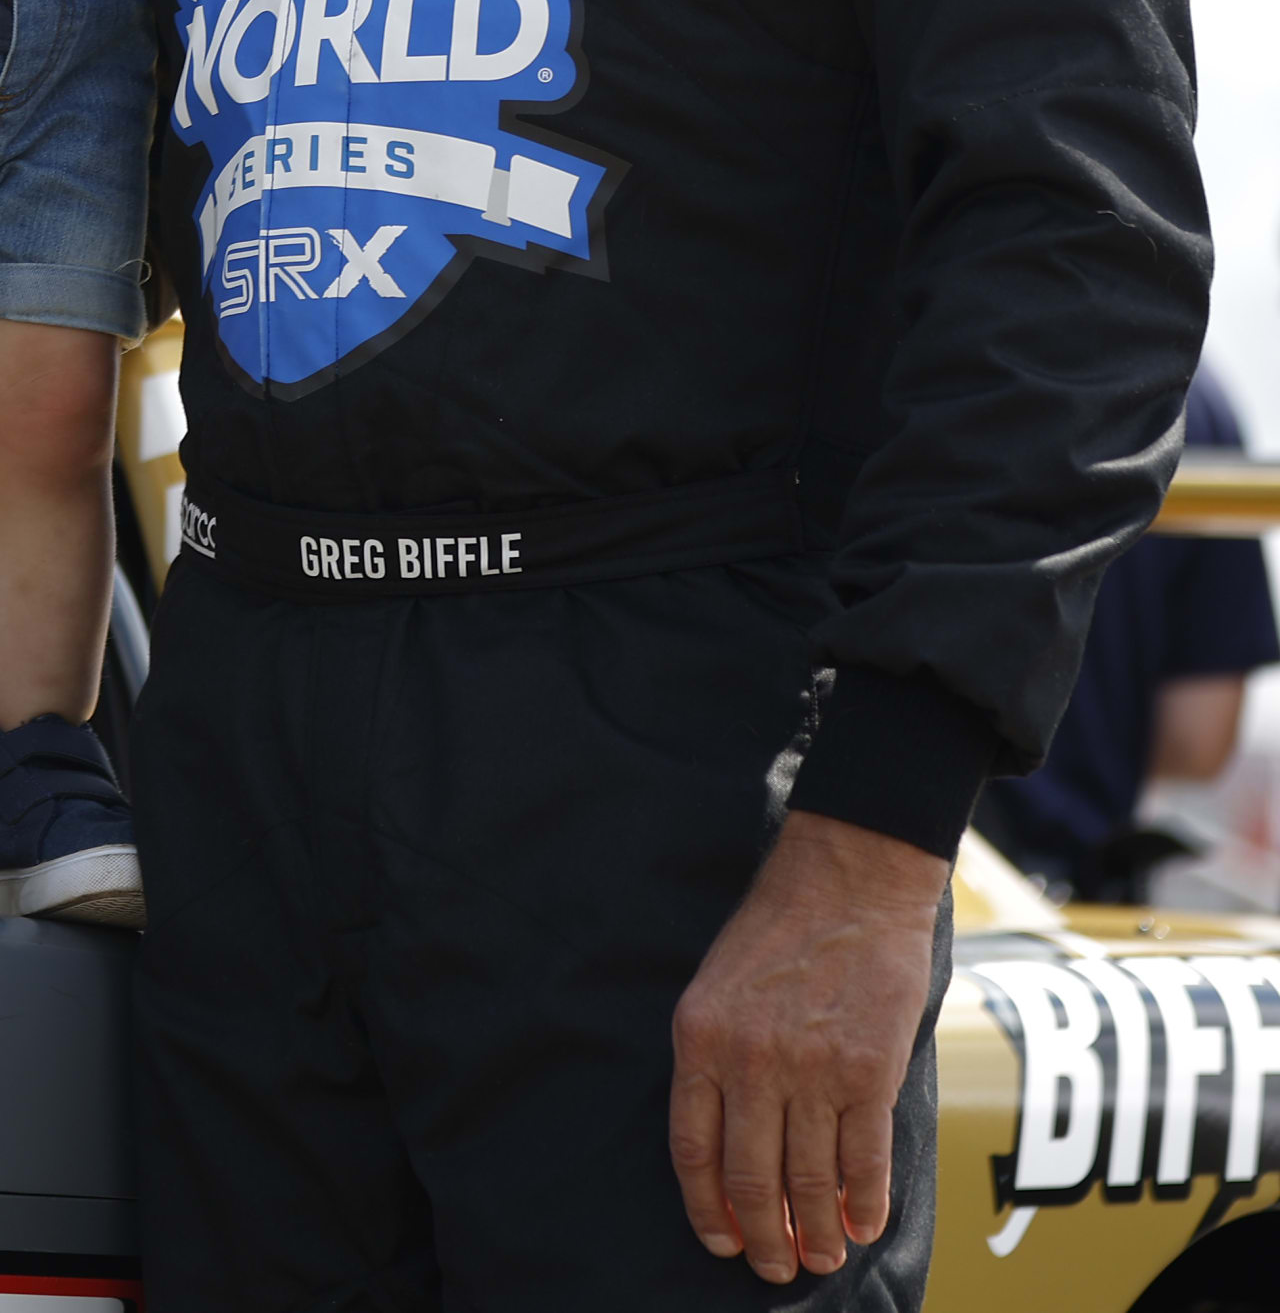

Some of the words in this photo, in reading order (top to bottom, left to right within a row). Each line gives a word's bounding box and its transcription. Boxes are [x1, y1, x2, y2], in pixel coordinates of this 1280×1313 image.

[228, 135, 416, 201] SERIES
[220, 225, 409, 319] SRX
[300, 535, 386, 580] GREG
[397, 532, 523, 579] BIFFLE
